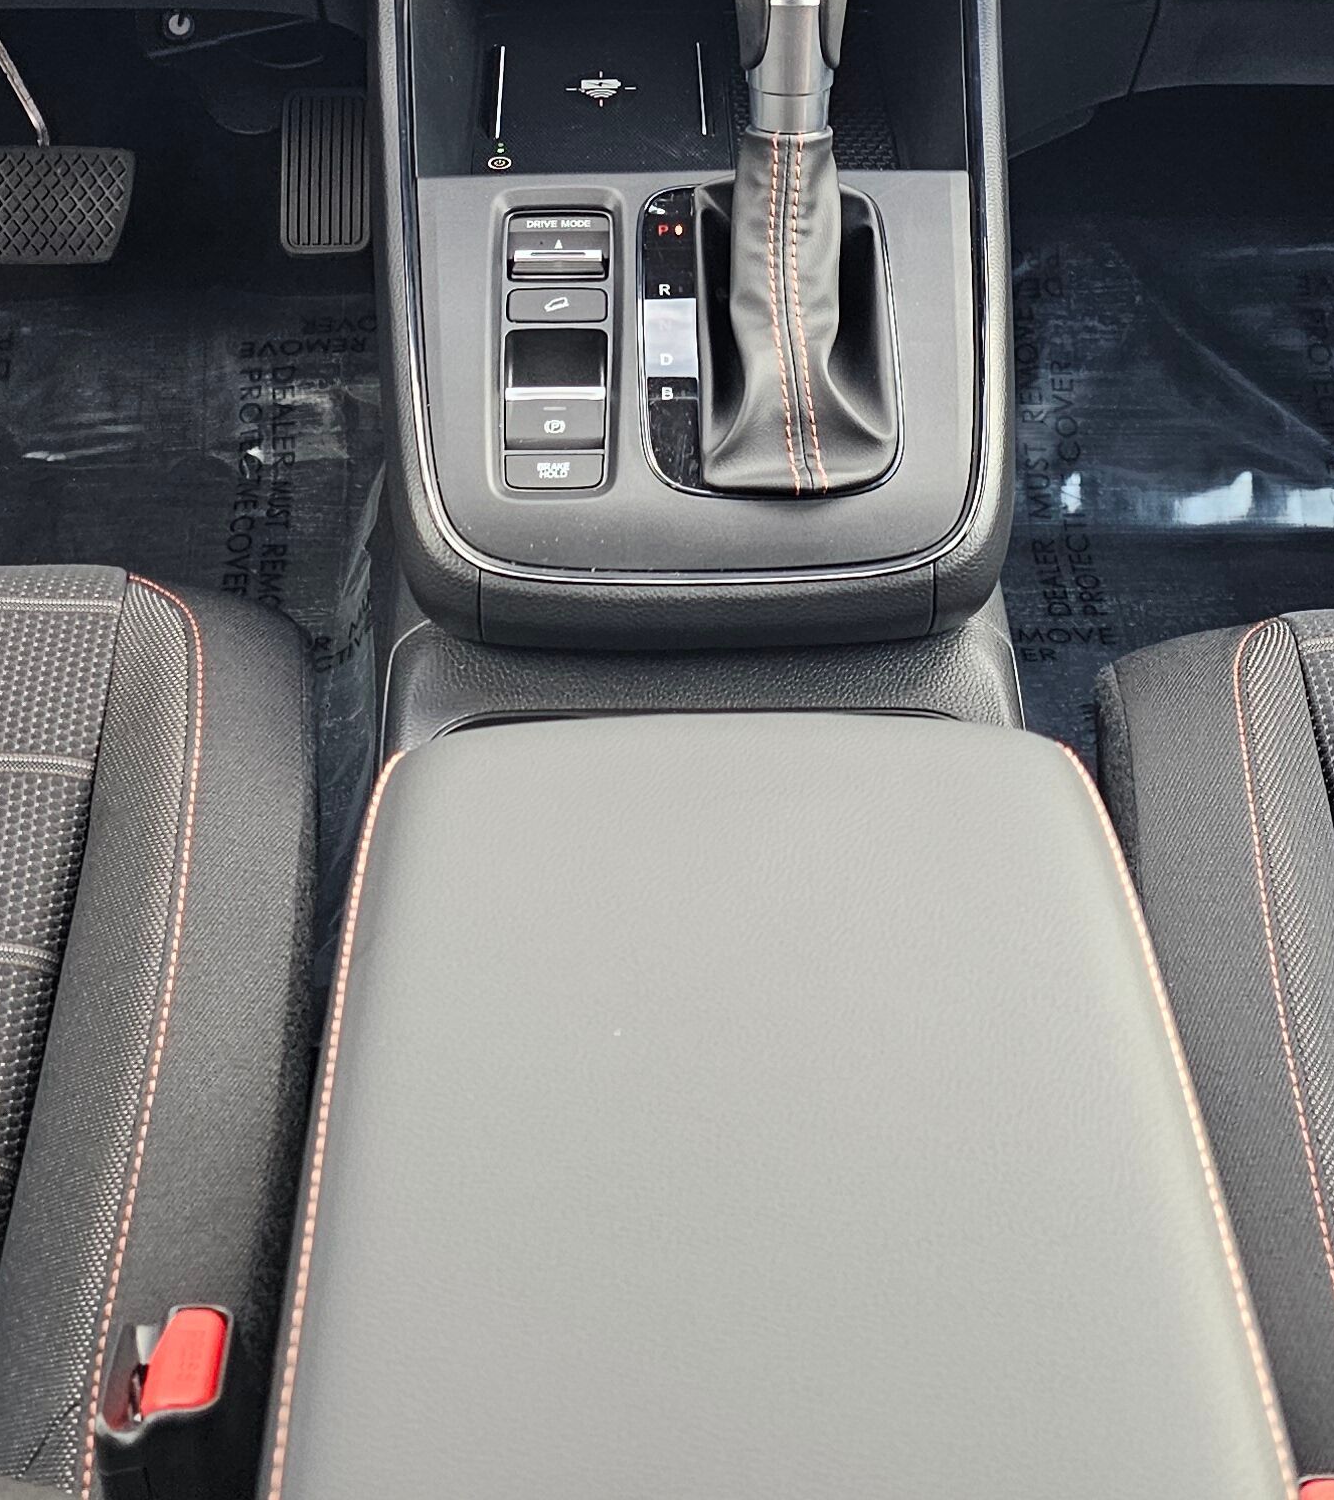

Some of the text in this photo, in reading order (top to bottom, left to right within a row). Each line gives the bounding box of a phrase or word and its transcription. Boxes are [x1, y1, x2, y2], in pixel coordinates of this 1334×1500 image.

[526, 218, 592, 229] DRIVE MODE
[657, 225, 668, 235] P
[659, 284, 671, 296] R
[660, 353, 673, 366] D
[661, 386, 673, 400] B
[1049, 359, 1082, 464] COVER
[266, 364, 296, 529] DEALER MUST
[537, 461, 570, 471] BRAKE
[538, 470, 568, 479] HOLD
[1021, 442, 1053, 520] MUST
[1032, 538, 1073, 617] DEALER
